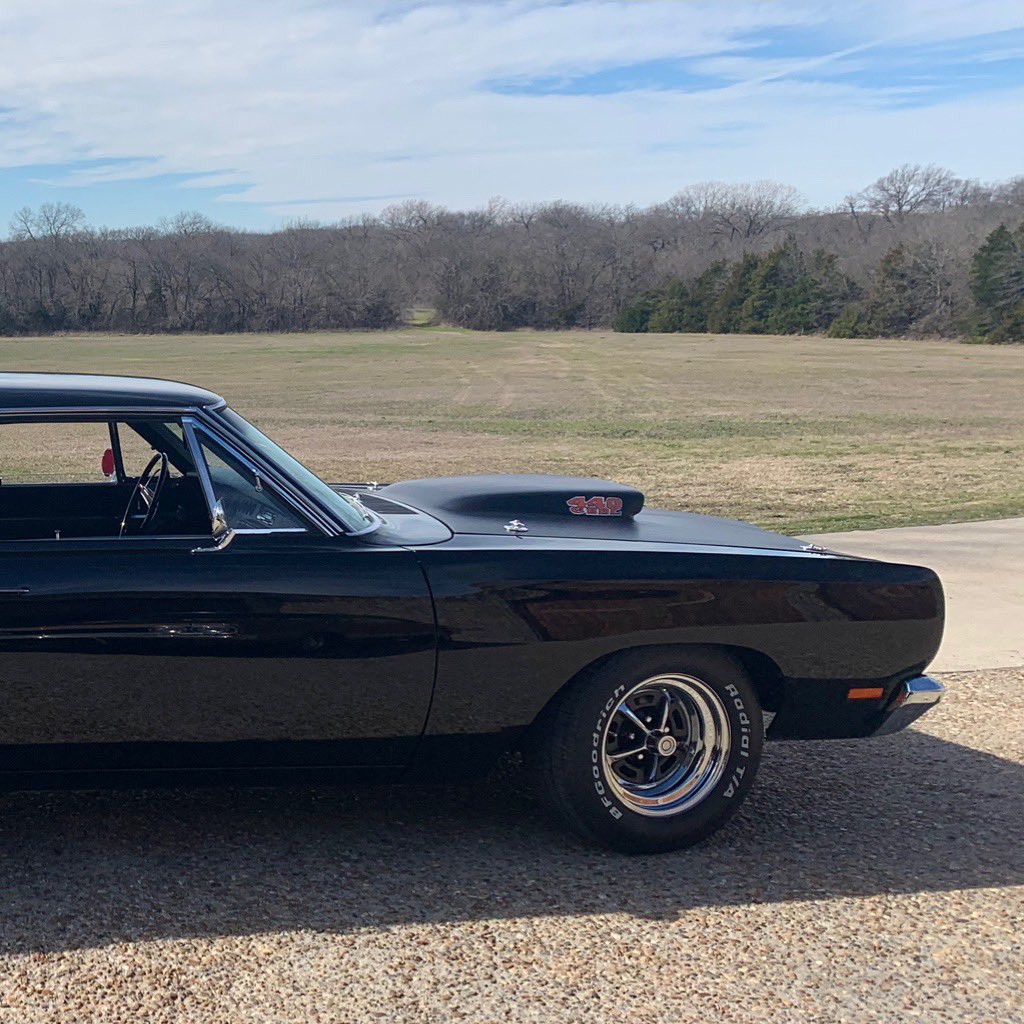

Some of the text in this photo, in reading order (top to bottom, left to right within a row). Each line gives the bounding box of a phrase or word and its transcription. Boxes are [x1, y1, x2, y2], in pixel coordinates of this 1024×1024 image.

[592, 685, 625, 819] BFGoodrich
[723, 684, 751, 797] Radial T/A
